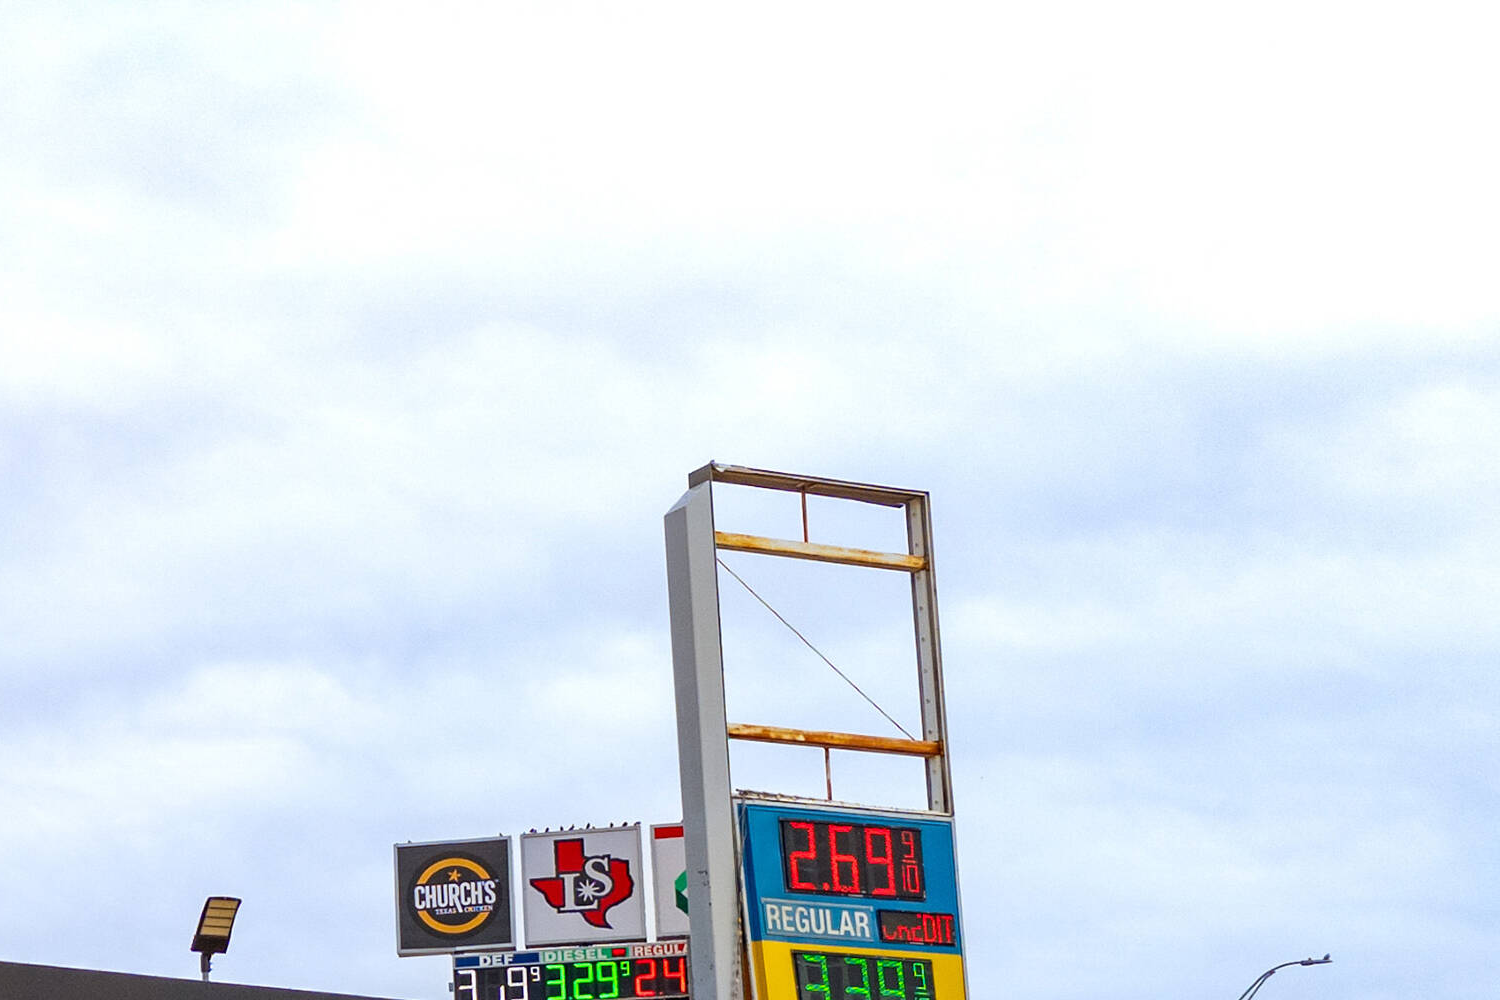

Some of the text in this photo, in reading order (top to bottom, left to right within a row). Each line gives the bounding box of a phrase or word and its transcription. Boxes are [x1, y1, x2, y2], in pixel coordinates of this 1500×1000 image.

[789, 822, 896, 895] 2.69
[414, 880, 497, 912] CHURCH'S
[765, 904, 871, 938] REGULAR
[479, 953, 514, 966] DEF
[544, 948, 607, 962] DIESEL
[634, 943, 687, 957] REGUL
